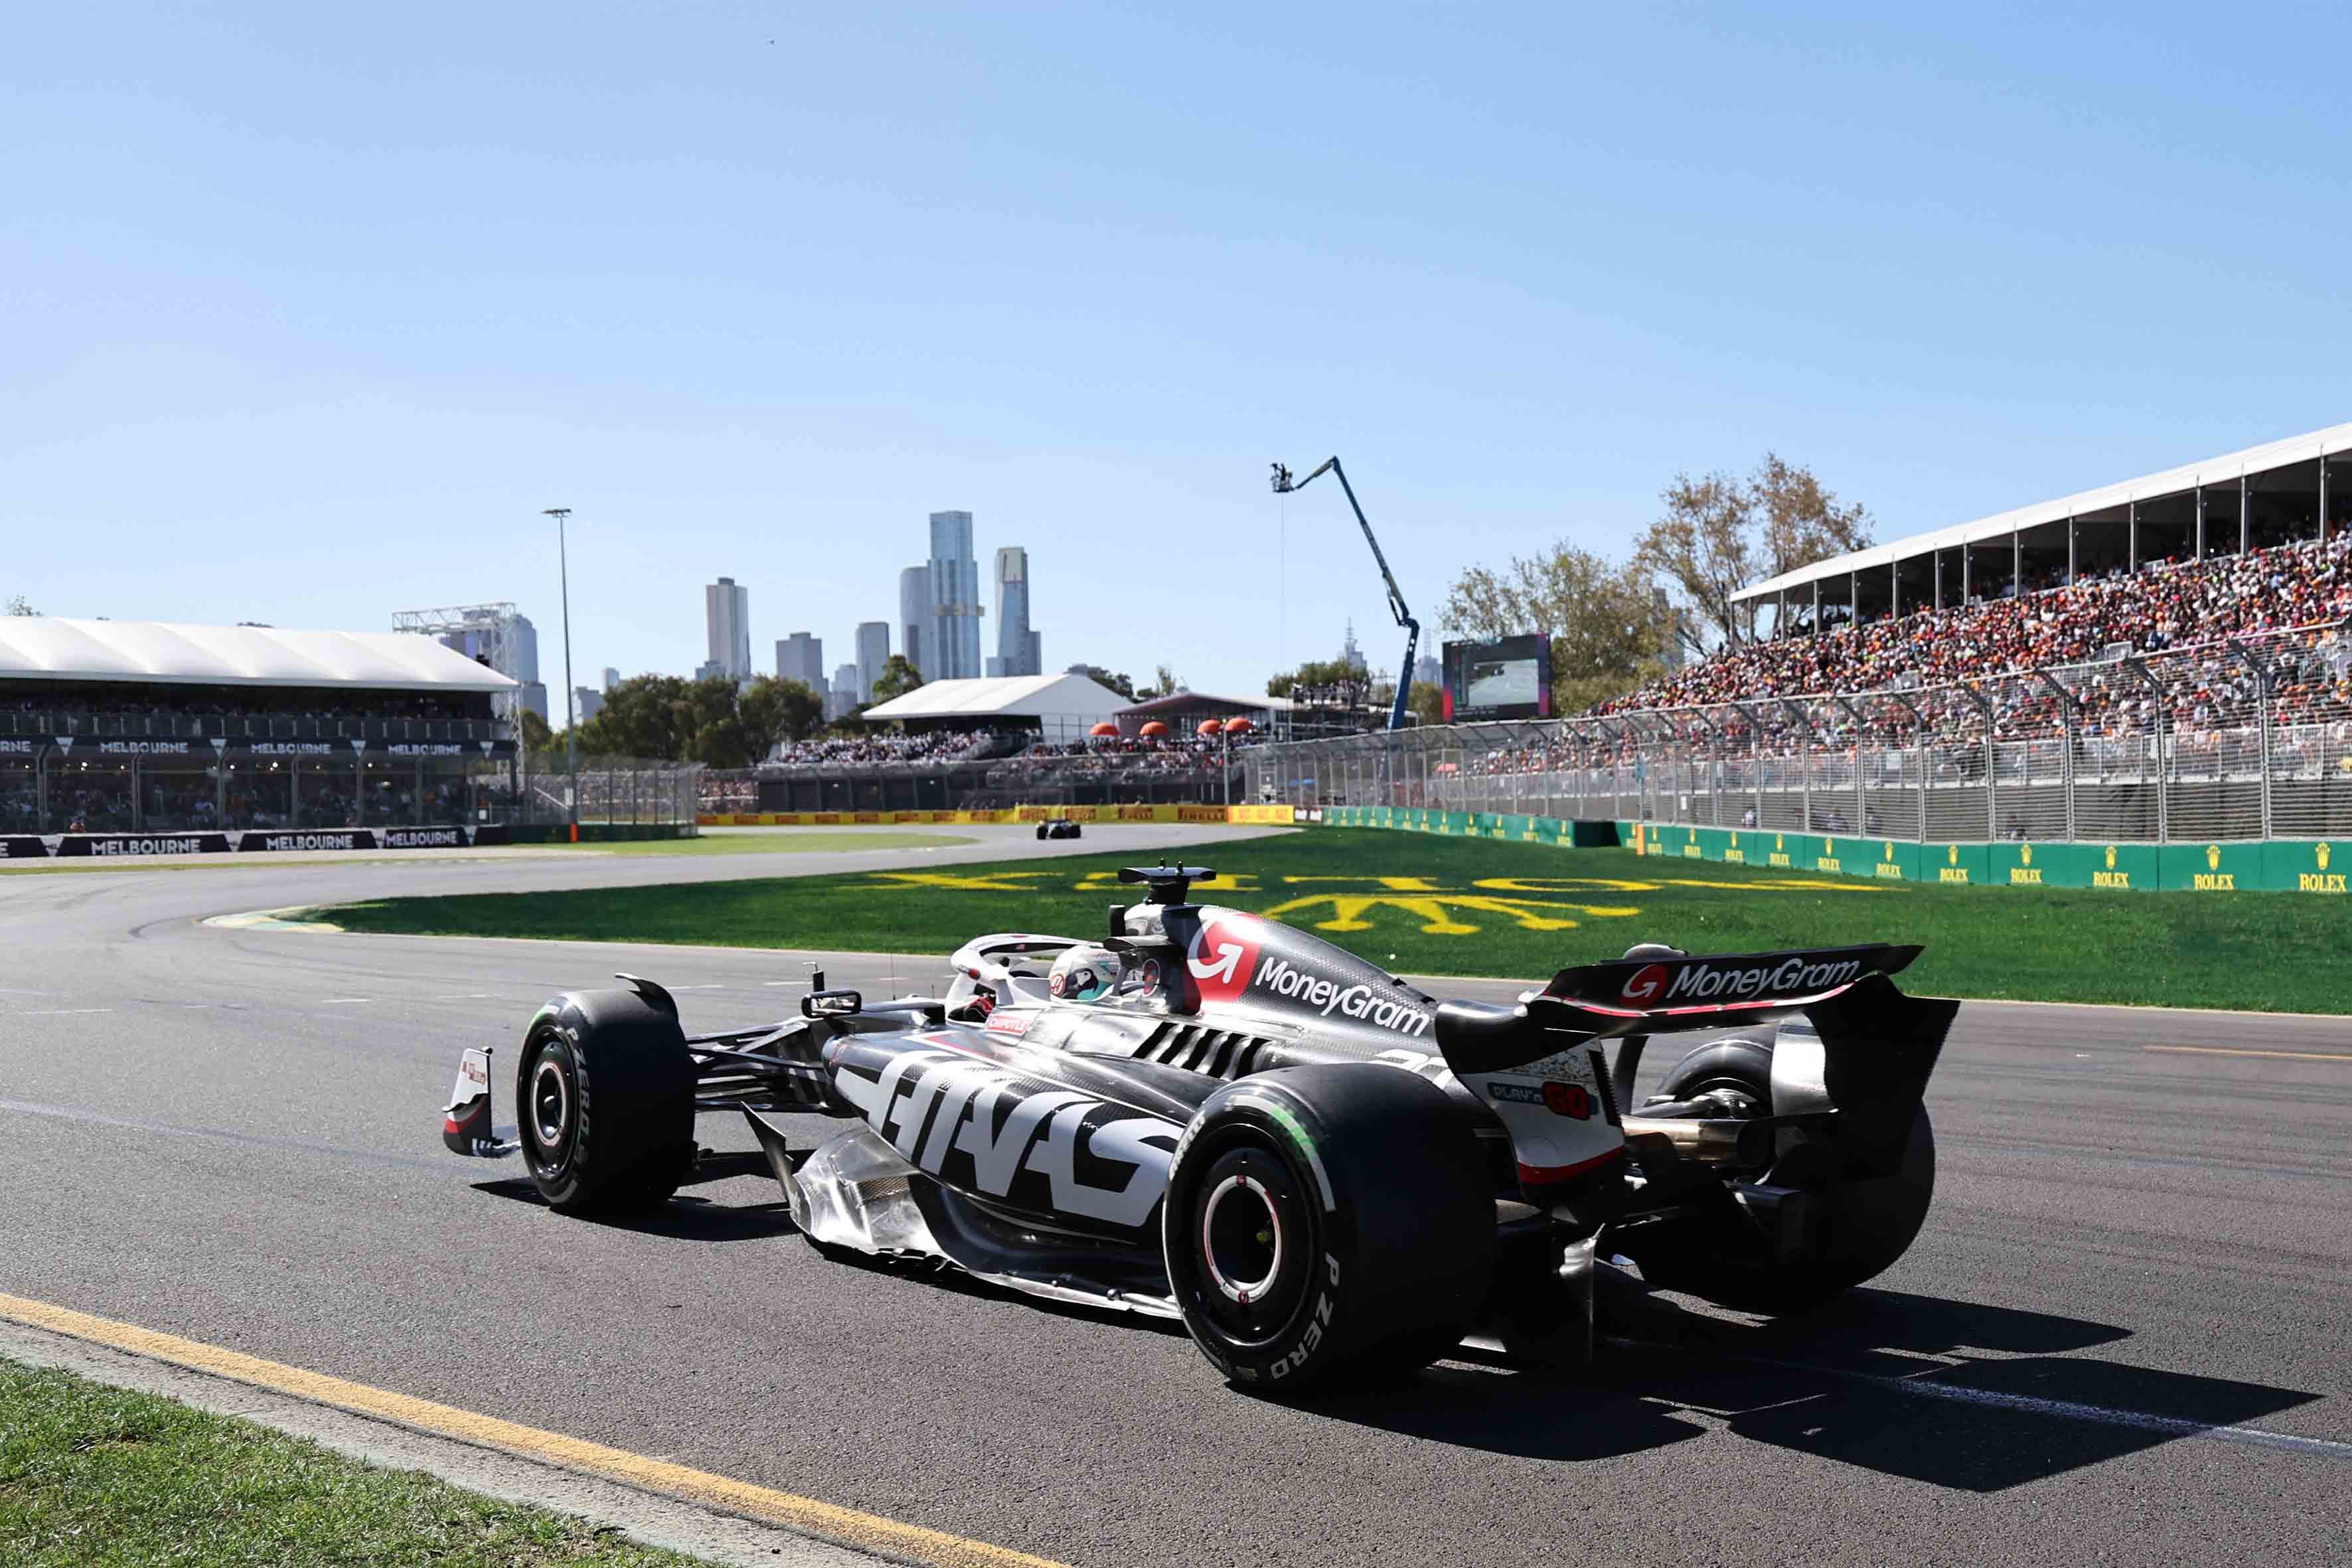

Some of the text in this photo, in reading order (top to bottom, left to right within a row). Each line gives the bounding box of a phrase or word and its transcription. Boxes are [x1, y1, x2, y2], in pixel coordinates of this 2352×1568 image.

[100, 742, 461, 755] MELBOURNE MELBOURNE MELBOURNE
[91, 831, 457, 856] MELBOURNE MELBOURNE MELBOURNE
[1818, 858, 1841, 872] ROLEX
[1875, 863, 1902, 878] ROLEX
[1939, 868, 1968, 883] ROLEX
[2011, 868, 2041, 884] ROLEX
[2093, 872, 2130, 888] ROLEX
[2194, 874, 2234, 891] ROLEX
[2300, 873, 2347, 892] ROLEX
[1255, 956, 1431, 1037] MoneyGram
[1666, 958, 1859, 999] MoneyGram
[834, 1050, 1187, 1227] HAAS
[1269, 1252, 1340, 1379] P ZERO
